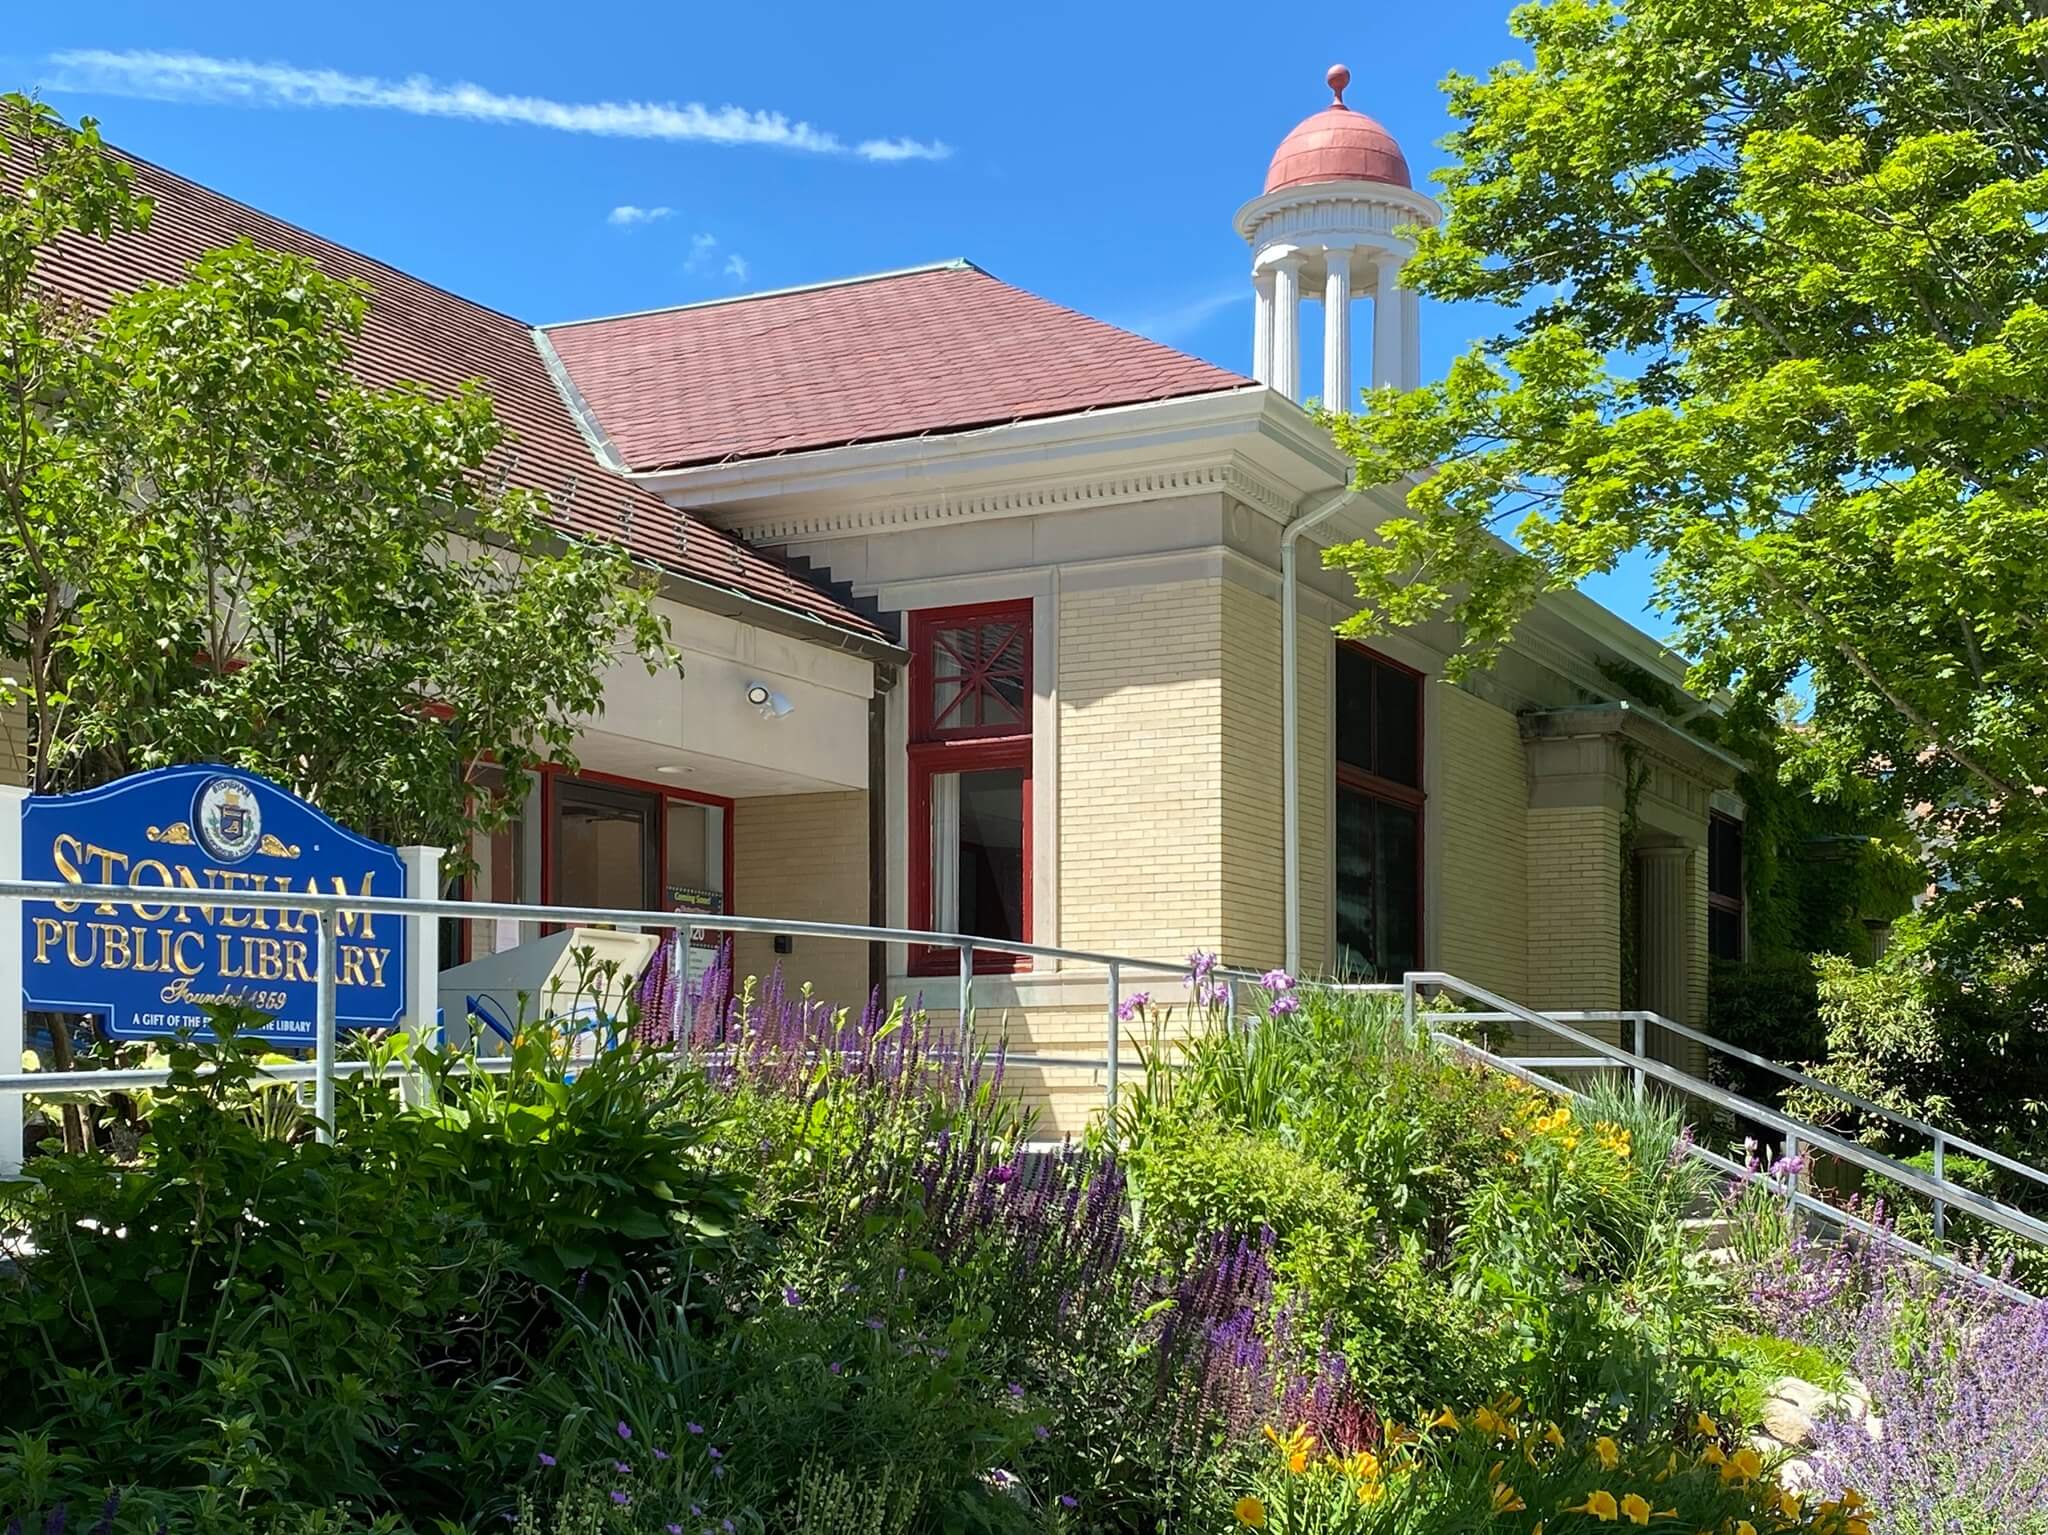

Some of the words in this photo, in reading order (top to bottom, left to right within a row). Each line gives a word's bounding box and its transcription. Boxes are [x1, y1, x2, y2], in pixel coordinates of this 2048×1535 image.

[53, 833, 375, 940] STONEHAM
[32, 917, 205, 976] PUBLIC
[216, 934, 391, 987] LIBRRY
[132, 1013, 140, 1025] A
[142, 1013, 165, 1026] GIFT
[166, 1014, 180, 1027] OF
[182, 1015, 201, 1028] THE
[276, 1020, 312, 1033] LIBRARY
